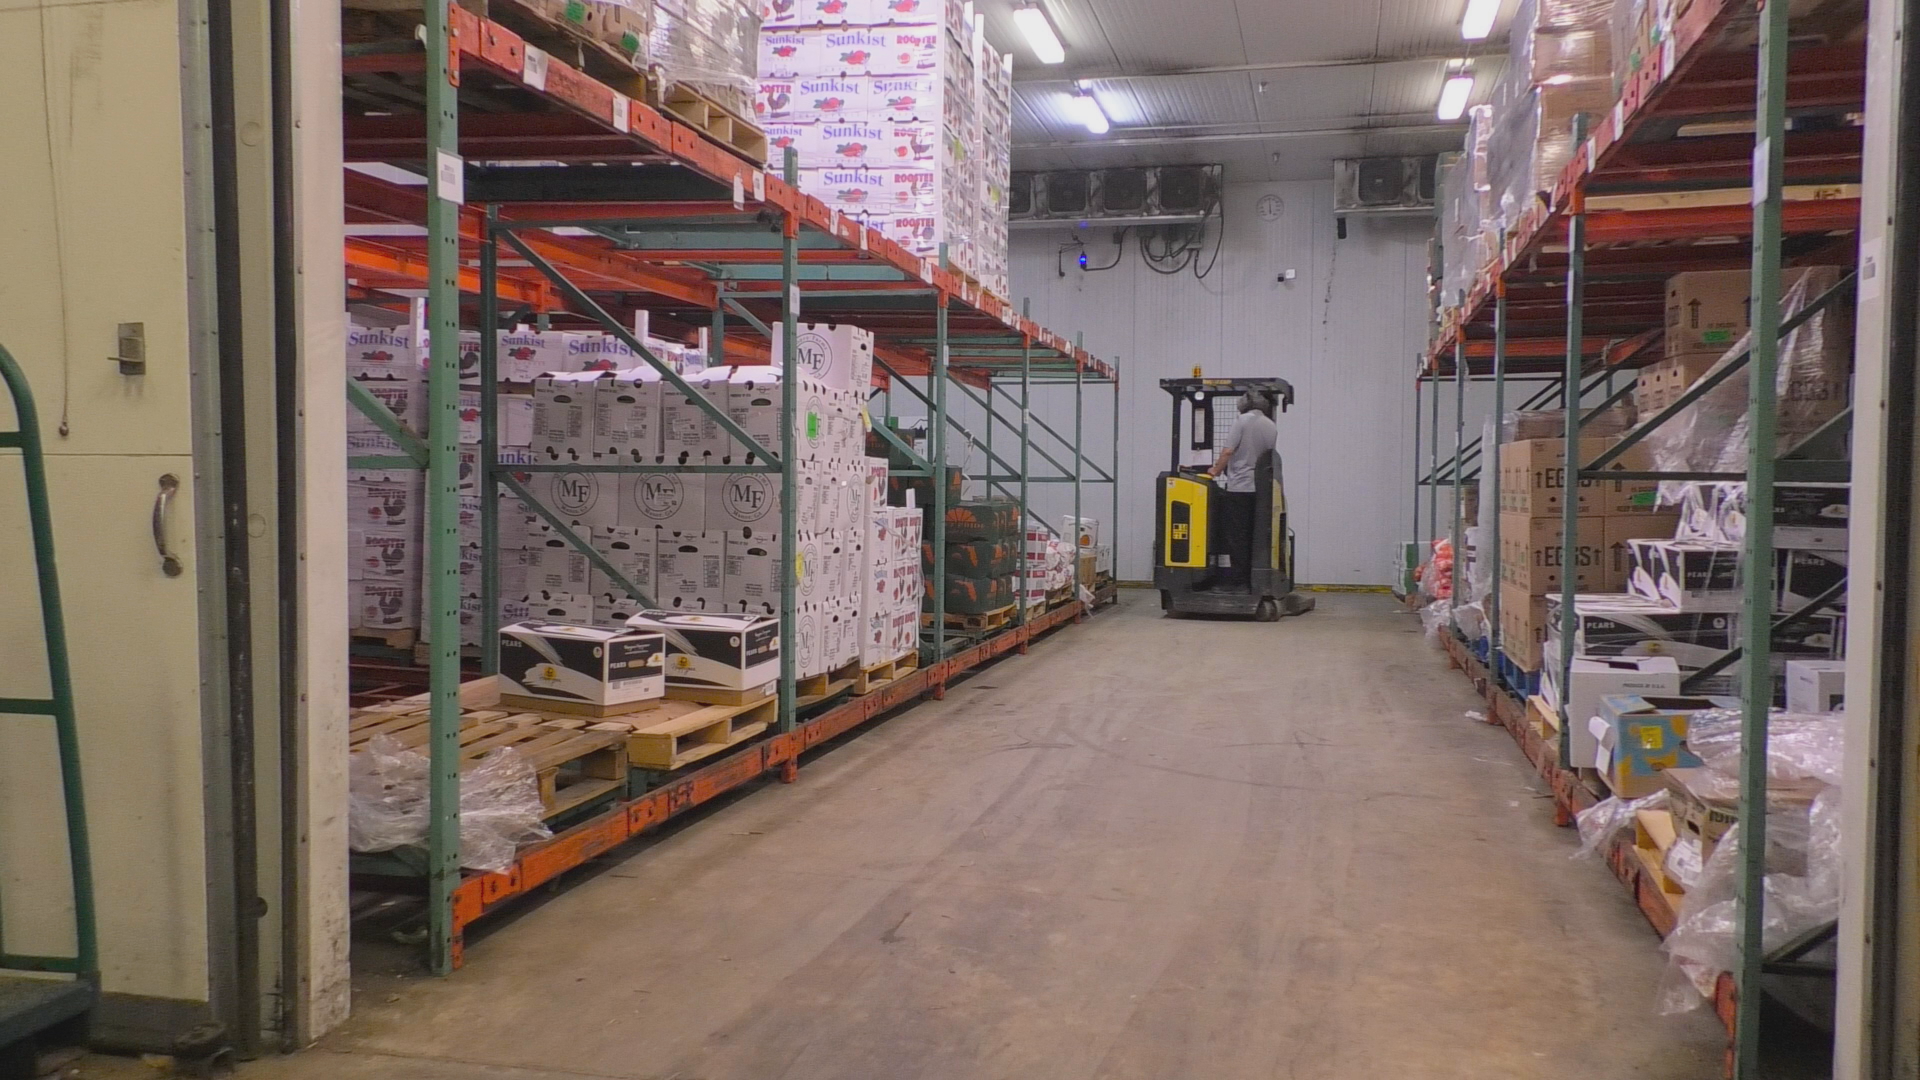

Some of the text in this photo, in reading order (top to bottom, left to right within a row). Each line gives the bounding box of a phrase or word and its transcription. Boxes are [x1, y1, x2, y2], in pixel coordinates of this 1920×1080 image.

[765, 35, 805, 46] Sunkist
[826, 31, 886, 48] Sunkist
[800, 78, 860, 95] Sunkist
[764, 125, 802, 136] Sunkist
[822, 123, 883, 140] Sunkist
[823, 169, 884, 187] Sunkist
[348, 329, 409, 349] Sunkist
[501, 335, 545, 349] Sunkist
[568, 338, 635, 358] Sunkist
[797, 347, 823, 369] MF
[561, 480, 589, 502] MF
[733, 484, 763, 508] MF
[1794, 557, 1825, 566] PEARS
[501, 640, 522, 648] PEARS
